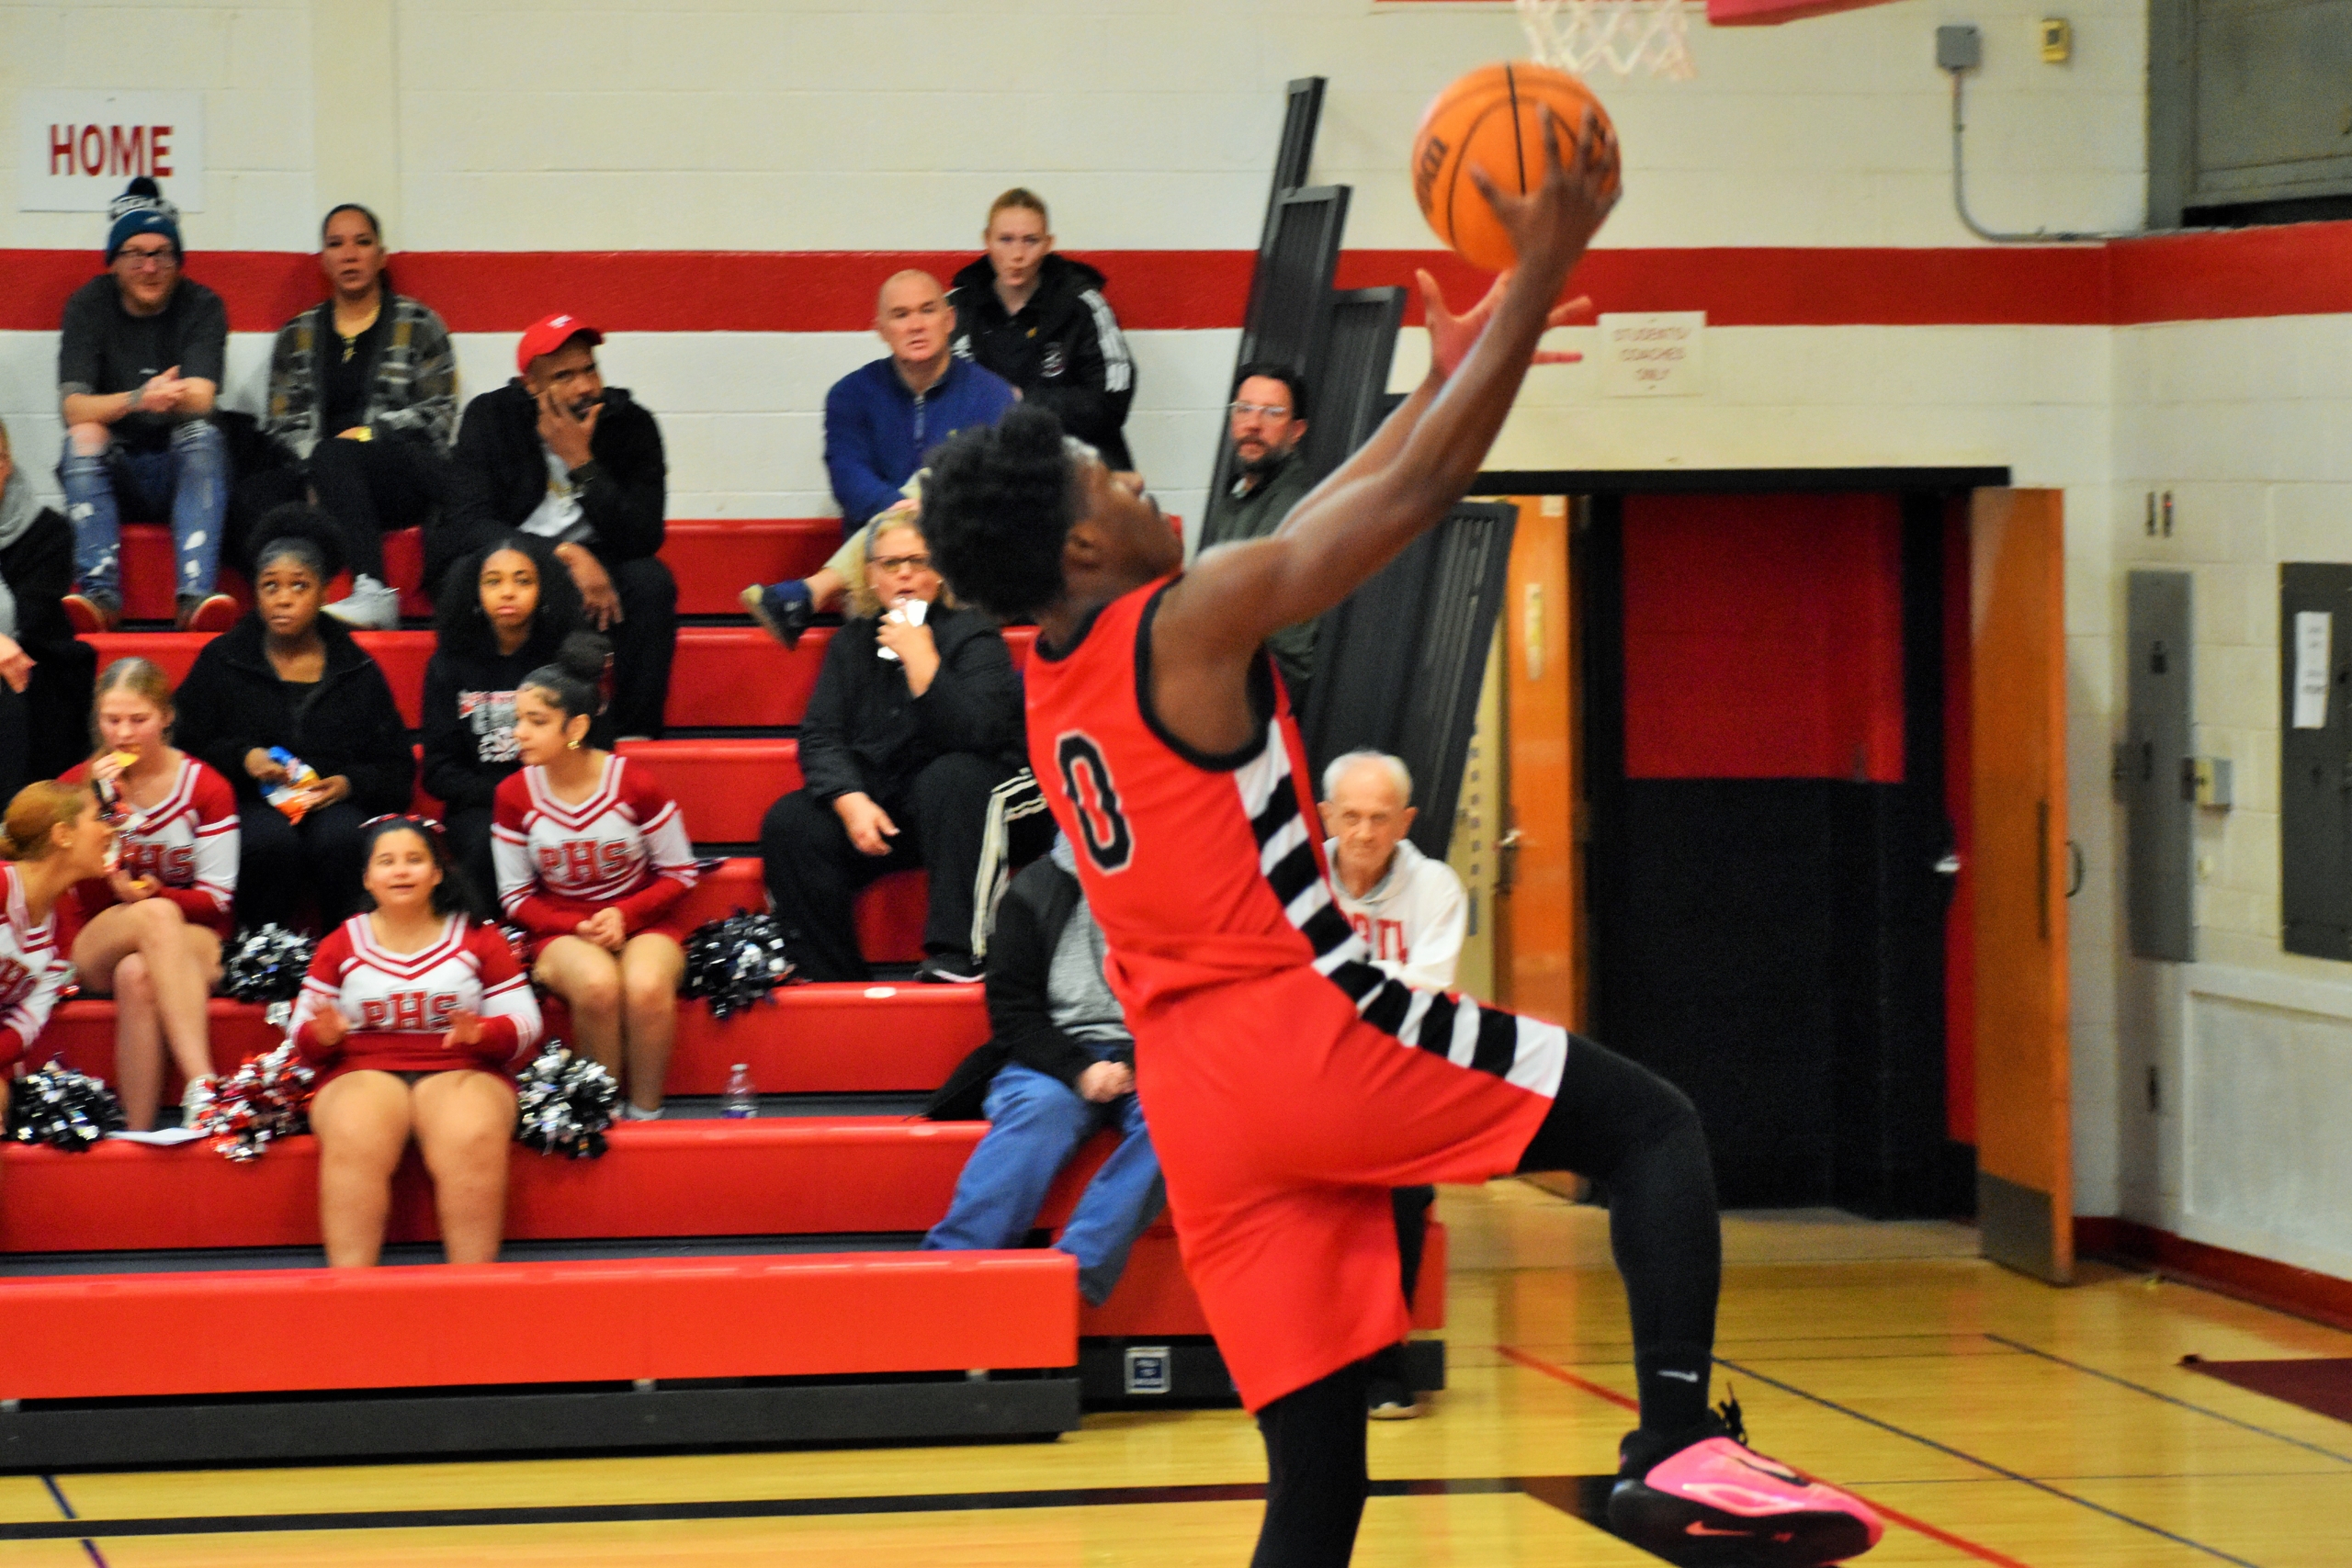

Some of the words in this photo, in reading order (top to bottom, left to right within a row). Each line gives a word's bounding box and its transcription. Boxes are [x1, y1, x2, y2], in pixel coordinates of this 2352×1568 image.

[50, 123, 174, 177] HOME
[1055, 729, 1136, 876] 0
[536, 840, 628, 882] PHS
[359, 990, 458, 1031] PHS
